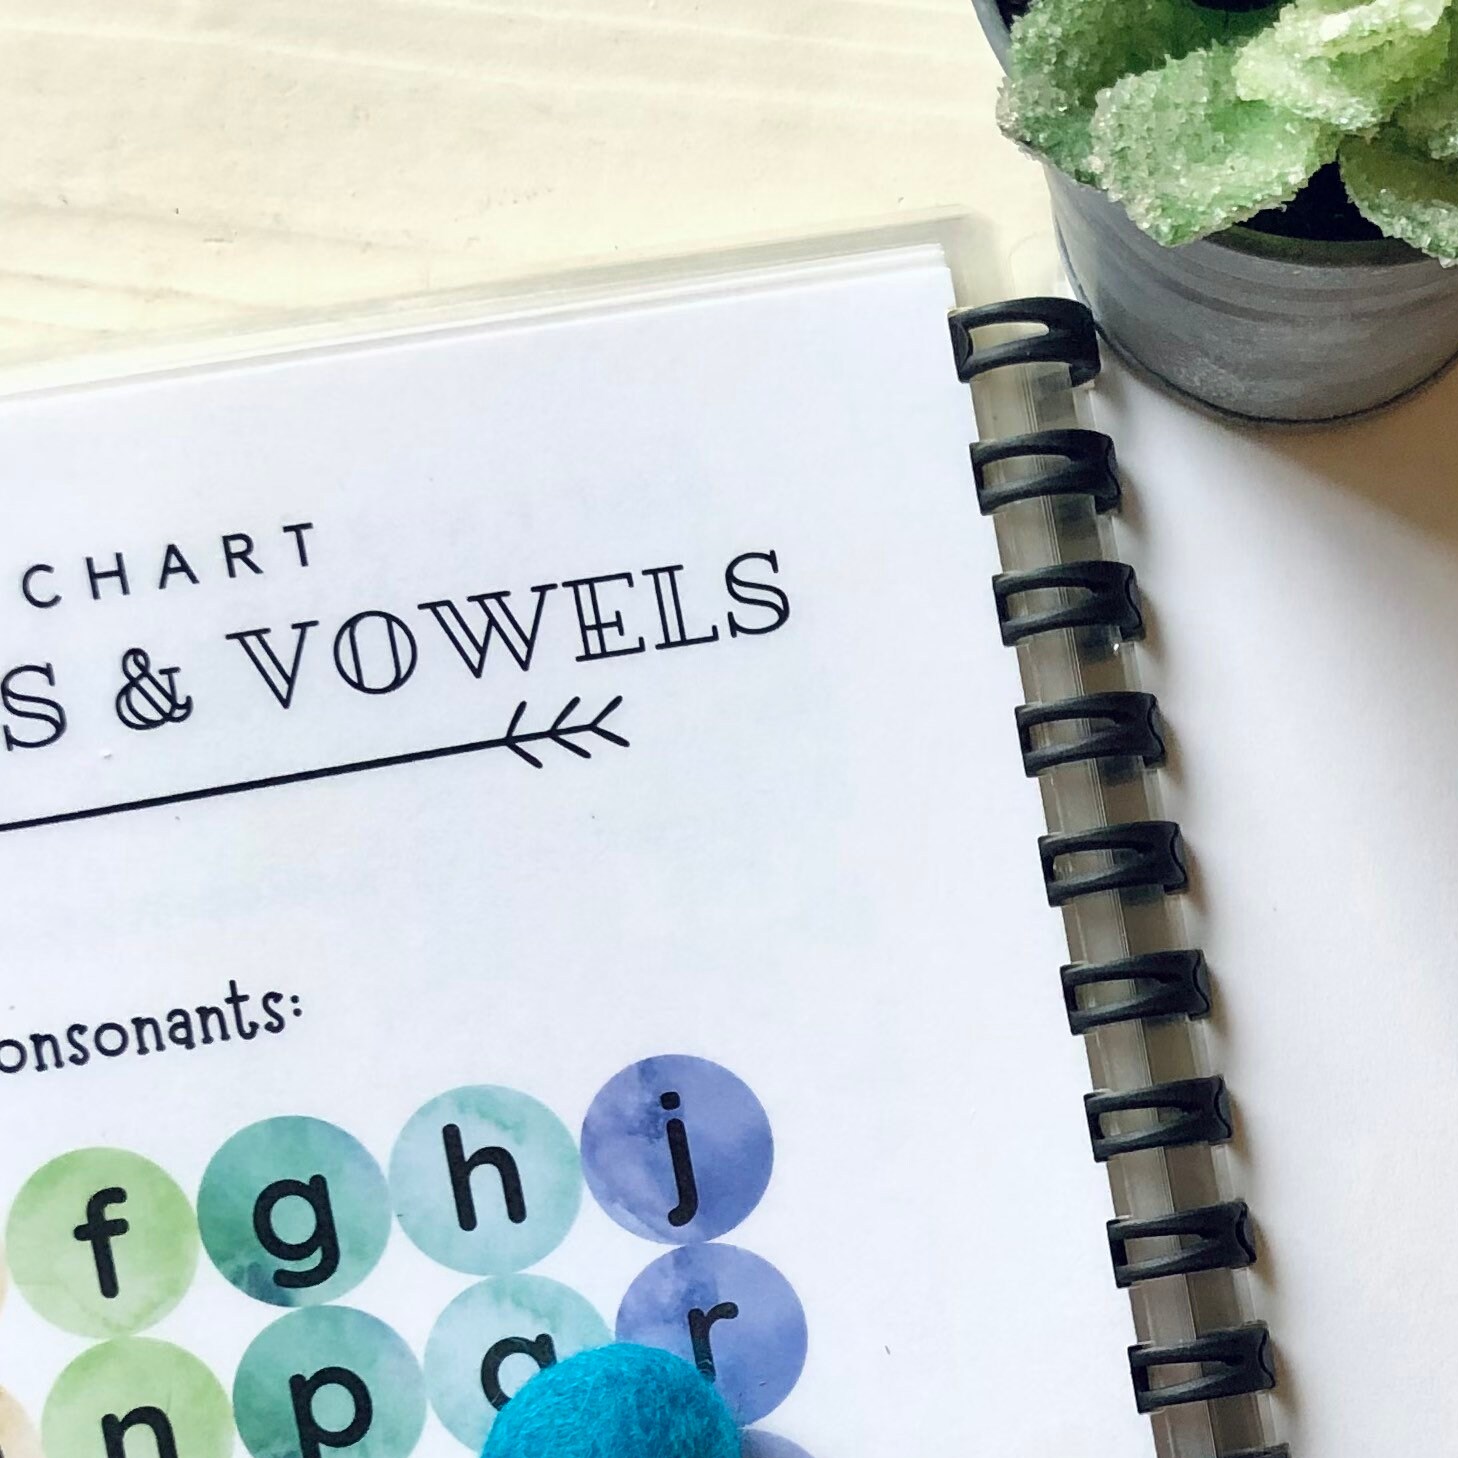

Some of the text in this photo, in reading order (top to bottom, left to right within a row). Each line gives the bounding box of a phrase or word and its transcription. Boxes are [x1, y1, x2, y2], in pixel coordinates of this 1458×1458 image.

[22, 522, 315, 609] CHART
[115, 647, 194, 731] &
[225, 549, 790, 710] VOWELS
[74, 1092, 698, 1298] f g h j
[688, 1301, 739, 1384] r
